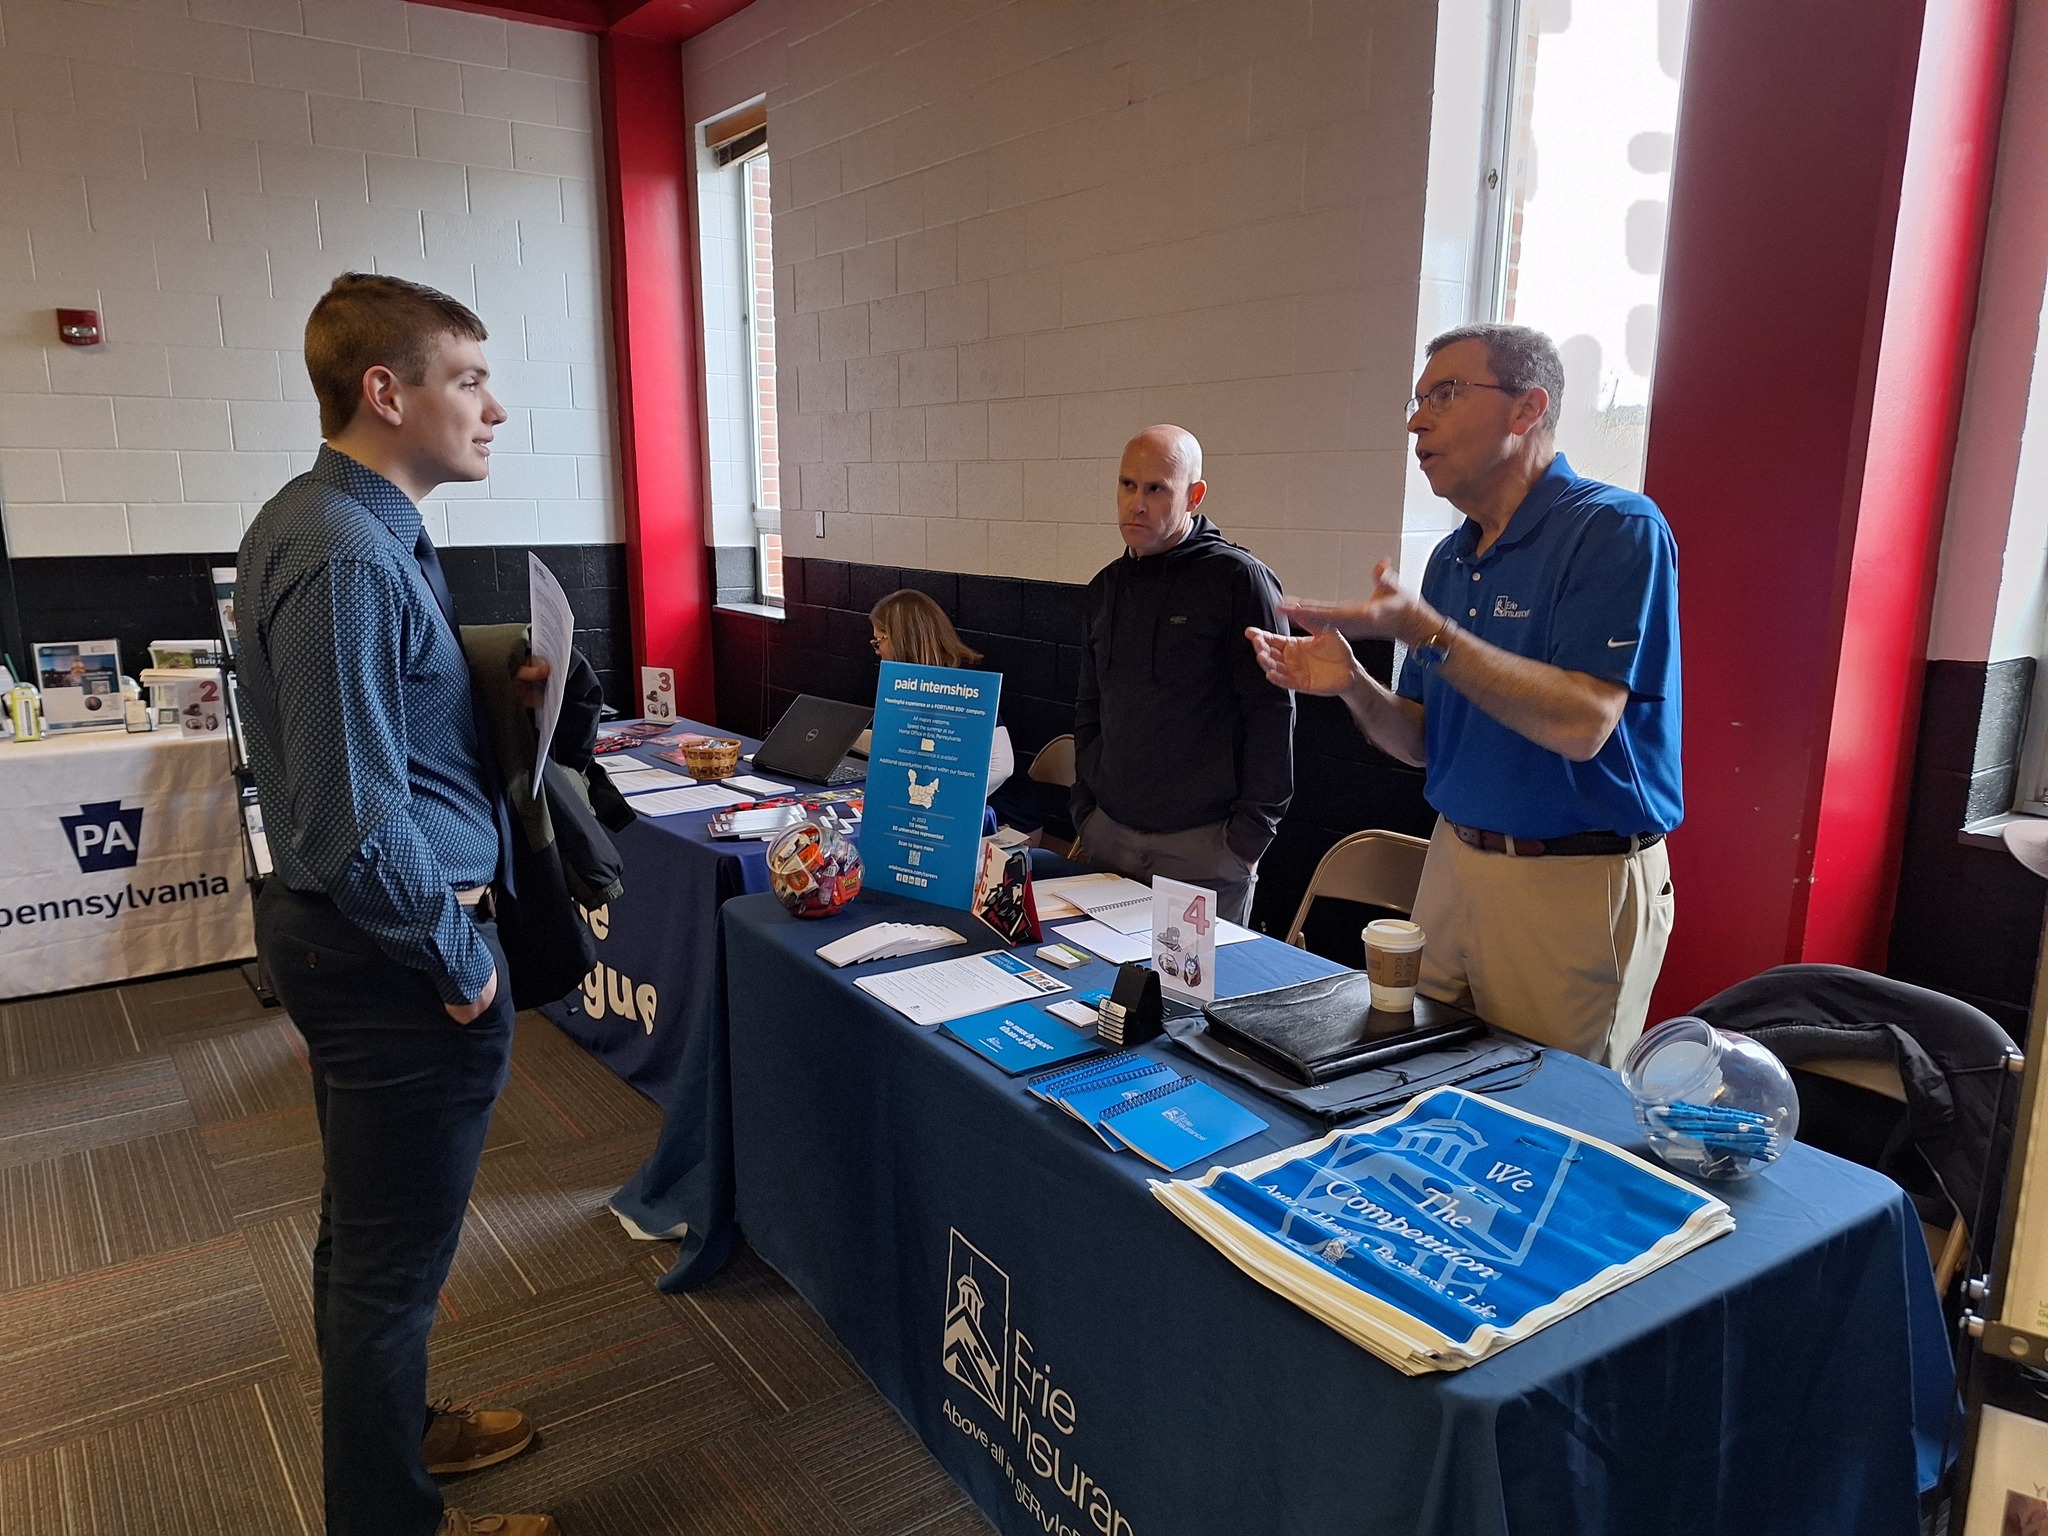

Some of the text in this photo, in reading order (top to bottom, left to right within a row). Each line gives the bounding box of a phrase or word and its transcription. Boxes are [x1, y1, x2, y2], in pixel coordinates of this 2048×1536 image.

[200, 680, 219, 702] 2
[658, 672, 671, 692] 3
[894, 678, 980, 699] paid internships
[879, 757, 897, 765] Additional
[898, 761, 922, 769] opportunities
[74, 820, 136, 859] PA
[920, 831, 944, 840] represented
[1183, 895, 1210, 936] 4
[1486, 1161, 1534, 1192] We
[1417, 1188, 1472, 1229] The
[1326, 1180, 1496, 1278] Competition
[1258, 1184, 1299, 1208] Auto
[1373, 1245, 1446, 1291] Business
[1457, 1293, 1498, 1320] Life
[1014, 1328, 1076, 1435] Erie
[942, 1398, 989, 1449] Above
[990, 1441, 1004, 1468] all
[1005, 1456, 1014, 1485] in
[1012, 1384, 1135, 1536] Insuran
